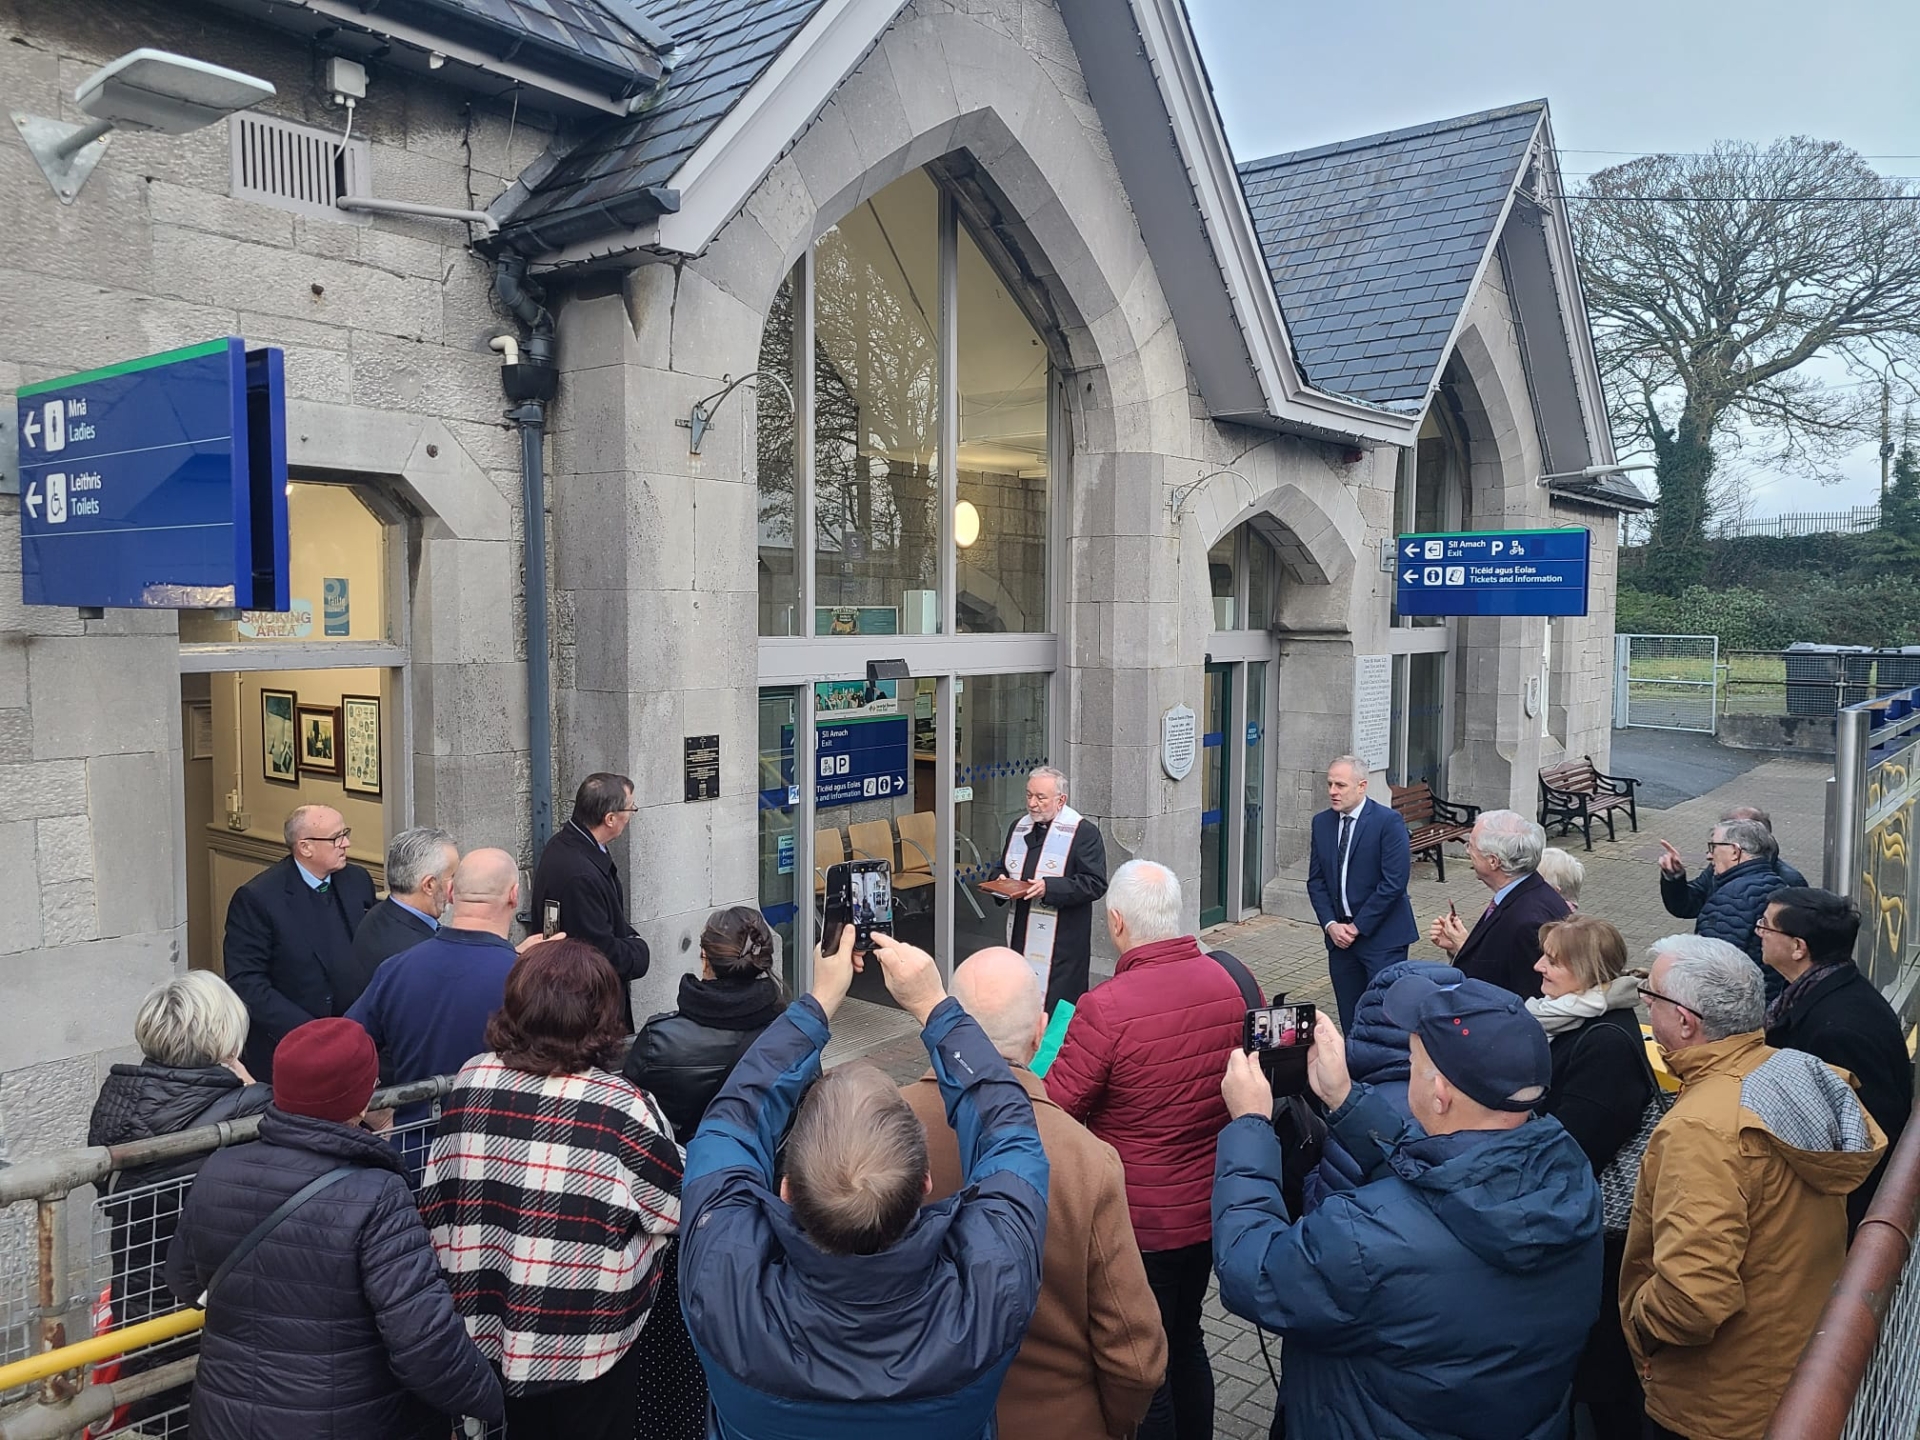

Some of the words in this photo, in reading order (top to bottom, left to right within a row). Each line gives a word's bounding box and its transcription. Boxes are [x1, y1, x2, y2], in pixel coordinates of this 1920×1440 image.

[69, 398, 87, 418] Mná
[69, 422, 96, 442] Ladies
[71, 471, 102, 491] Leithris
[71, 497, 100, 516] Toilets
[1447, 549, 1463, 557] Exit
[1460, 539, 1486, 548] Amach
[1491, 540, 1504, 556] P
[1469, 566, 1493, 575] Ticéid
[1494, 566, 1513, 576] agus
[1514, 566, 1537, 574] Eolas
[1469, 575, 1498, 583] Tickets
[1514, 574, 1563, 583] Information
[242, 611, 312, 624] SMOKING
[256, 624, 297, 637] AREA
[830, 729, 848, 738] Amach
[821, 739, 832, 748] Exit
[819, 794, 829, 802] and
[831, 789, 861, 799] Information
